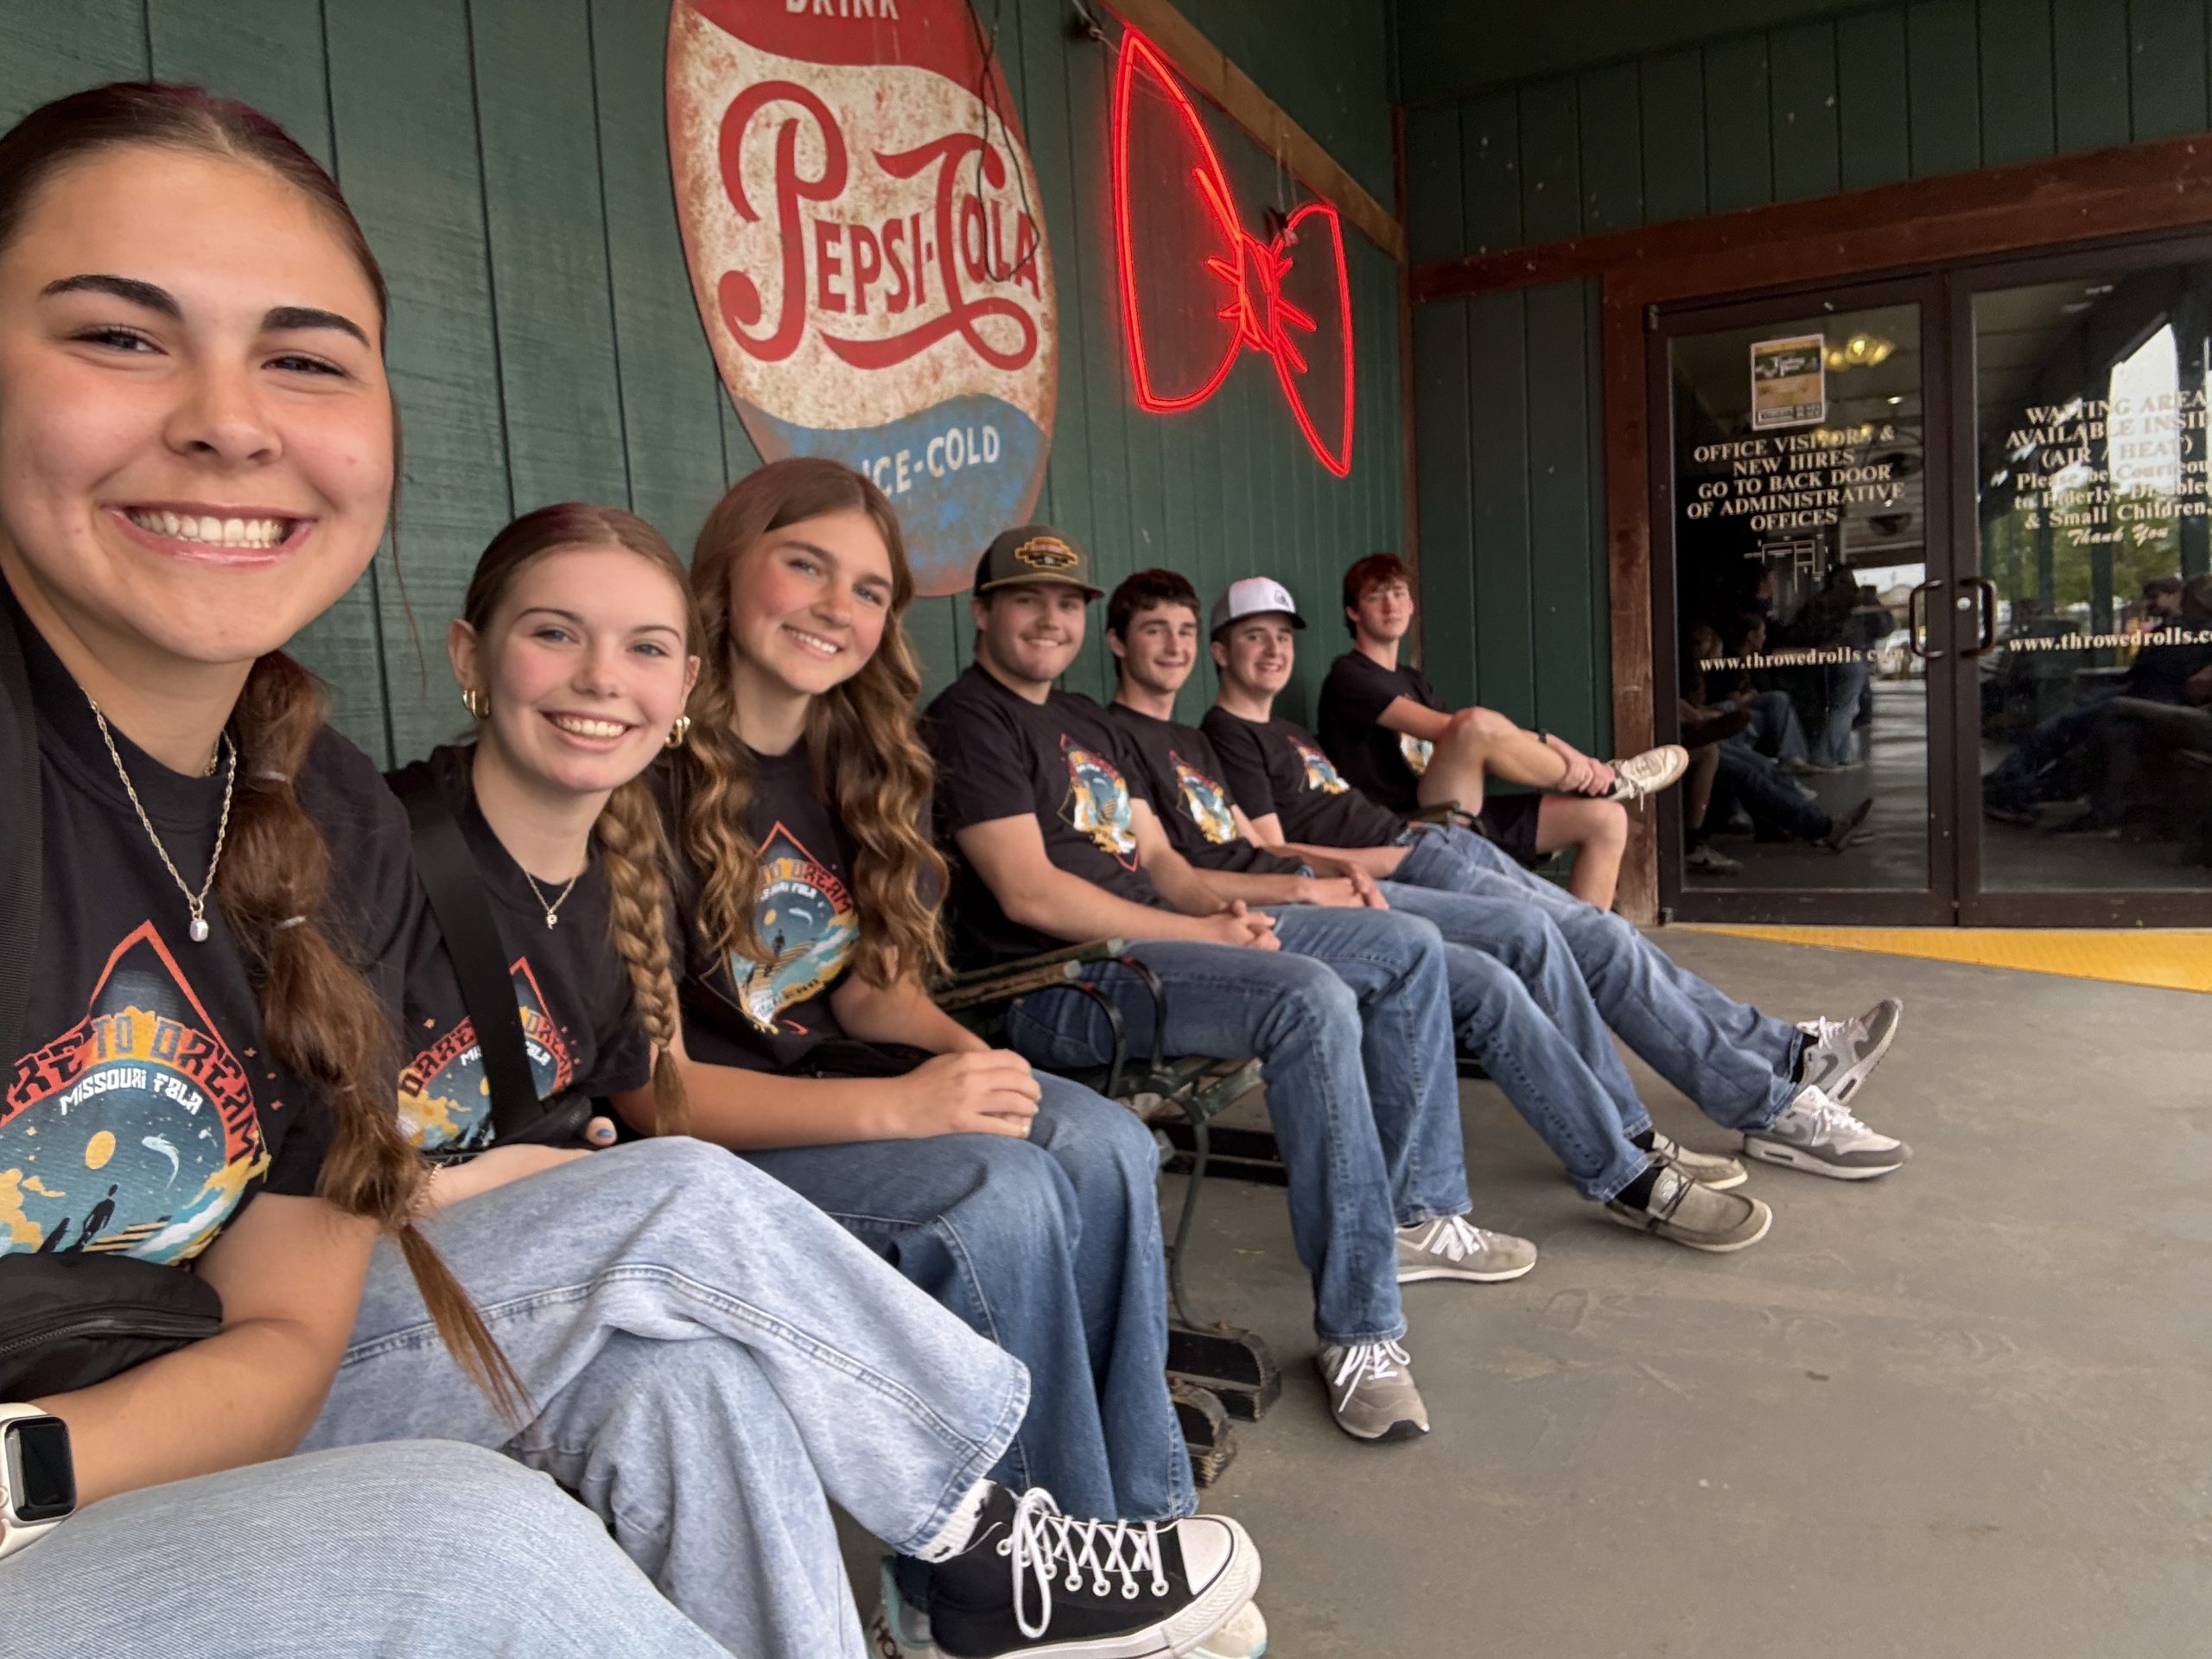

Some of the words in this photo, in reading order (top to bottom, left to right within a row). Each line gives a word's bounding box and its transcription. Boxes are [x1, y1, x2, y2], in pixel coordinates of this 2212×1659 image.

[2025, 397, 2132, 425] WATING
[1694, 438, 1768, 463] OFFICE
[1879, 424, 1896, 442] &
[1732, 455, 1782, 478] NEW
[1789, 448, 1856, 472] HIRES
[1698, 480, 1729, 499] GO
[1733, 477, 1763, 497] TO
[1770, 472, 1823, 493] BACK
[1830, 463, 1894, 486] DOOR
[2016, 472, 2080, 492] Plea
[1687, 501, 1715, 519] OF
[1719, 481, 1905, 517] ADMINISTRATIVE
[2042, 486, 2120, 508] Ederly,
[1750, 507, 1839, 532] OFFICES
[2024, 512, 2041, 531] &
[2048, 505, 2108, 527] Small
[2067, 524, 2125, 547] Thank
[2132, 522, 2170, 548] You
[2009, 626, 2212, 652] www.throwedrolls.c
[1699, 645, 1905, 672] www.throwedrollscom
[92, 1015, 133, 1058] TO
[149, 1017, 258, 1165] DREAM
[154, 1072, 204, 1115] FBLA
